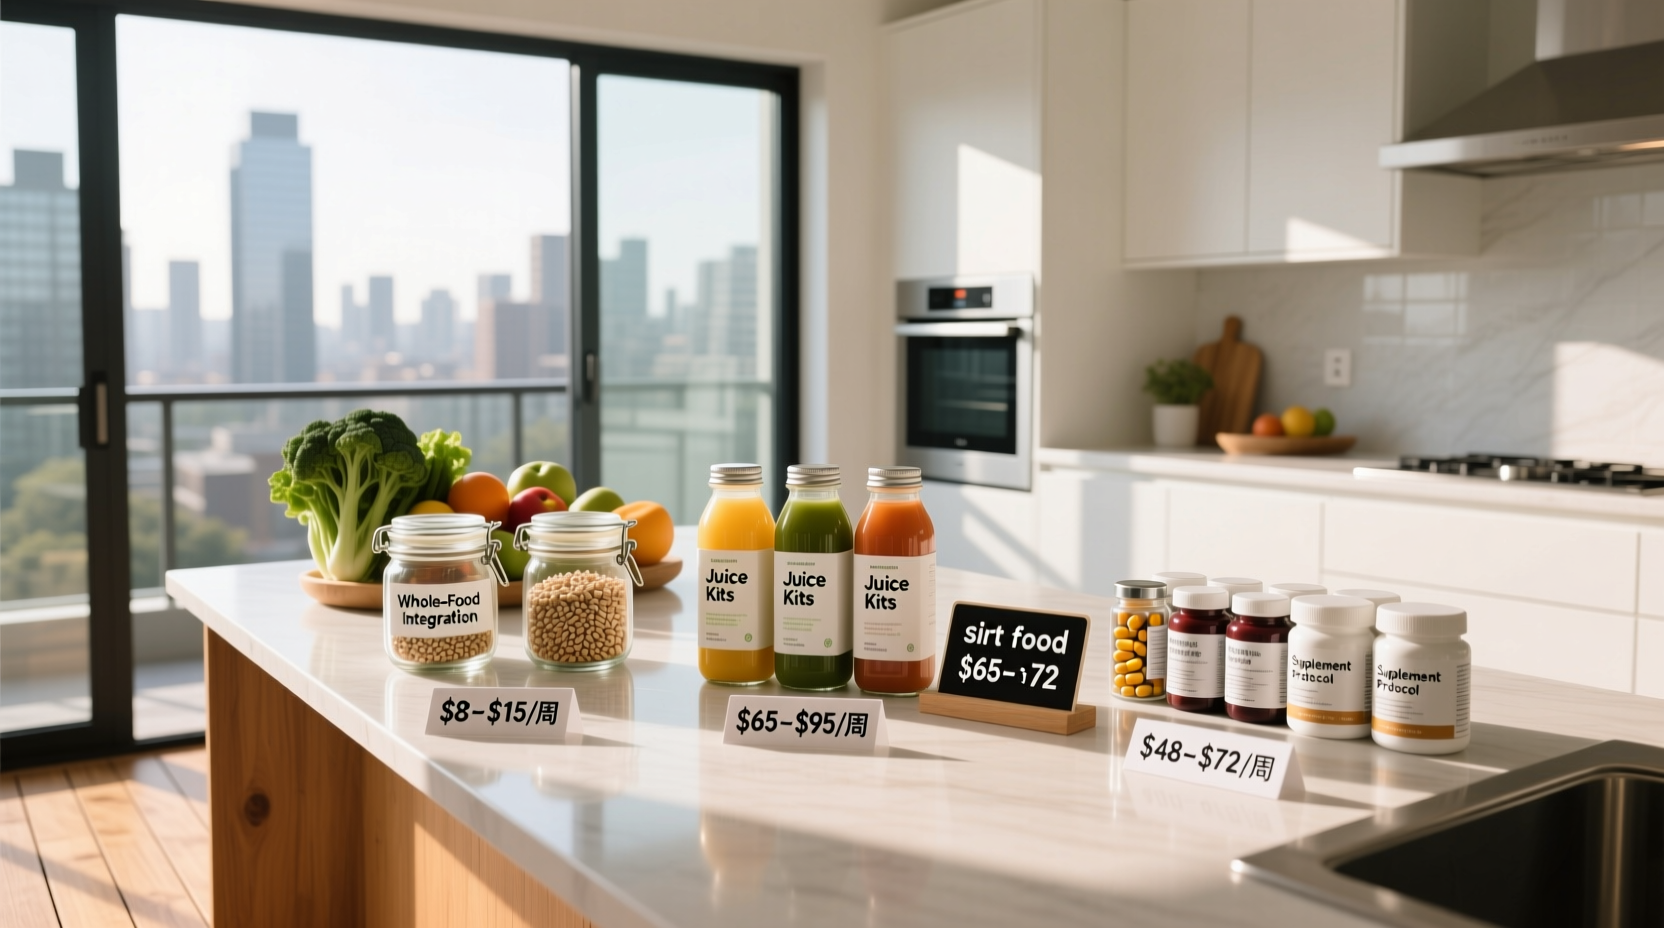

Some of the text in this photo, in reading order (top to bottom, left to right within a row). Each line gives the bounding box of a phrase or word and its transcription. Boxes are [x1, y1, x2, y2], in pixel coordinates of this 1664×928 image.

[705, 568, 749, 585] Juice
[782, 570, 827, 588] Juice
[864, 574, 910, 592] Juice
[397, 591, 480, 609] Whole-Food
[706, 585, 735, 603] Kits
[783, 588, 815, 607] Kits
[864, 592, 897, 611] Kits
[402, 609, 478, 630] Integration
[963, 621, 1070, 655] sirt food
